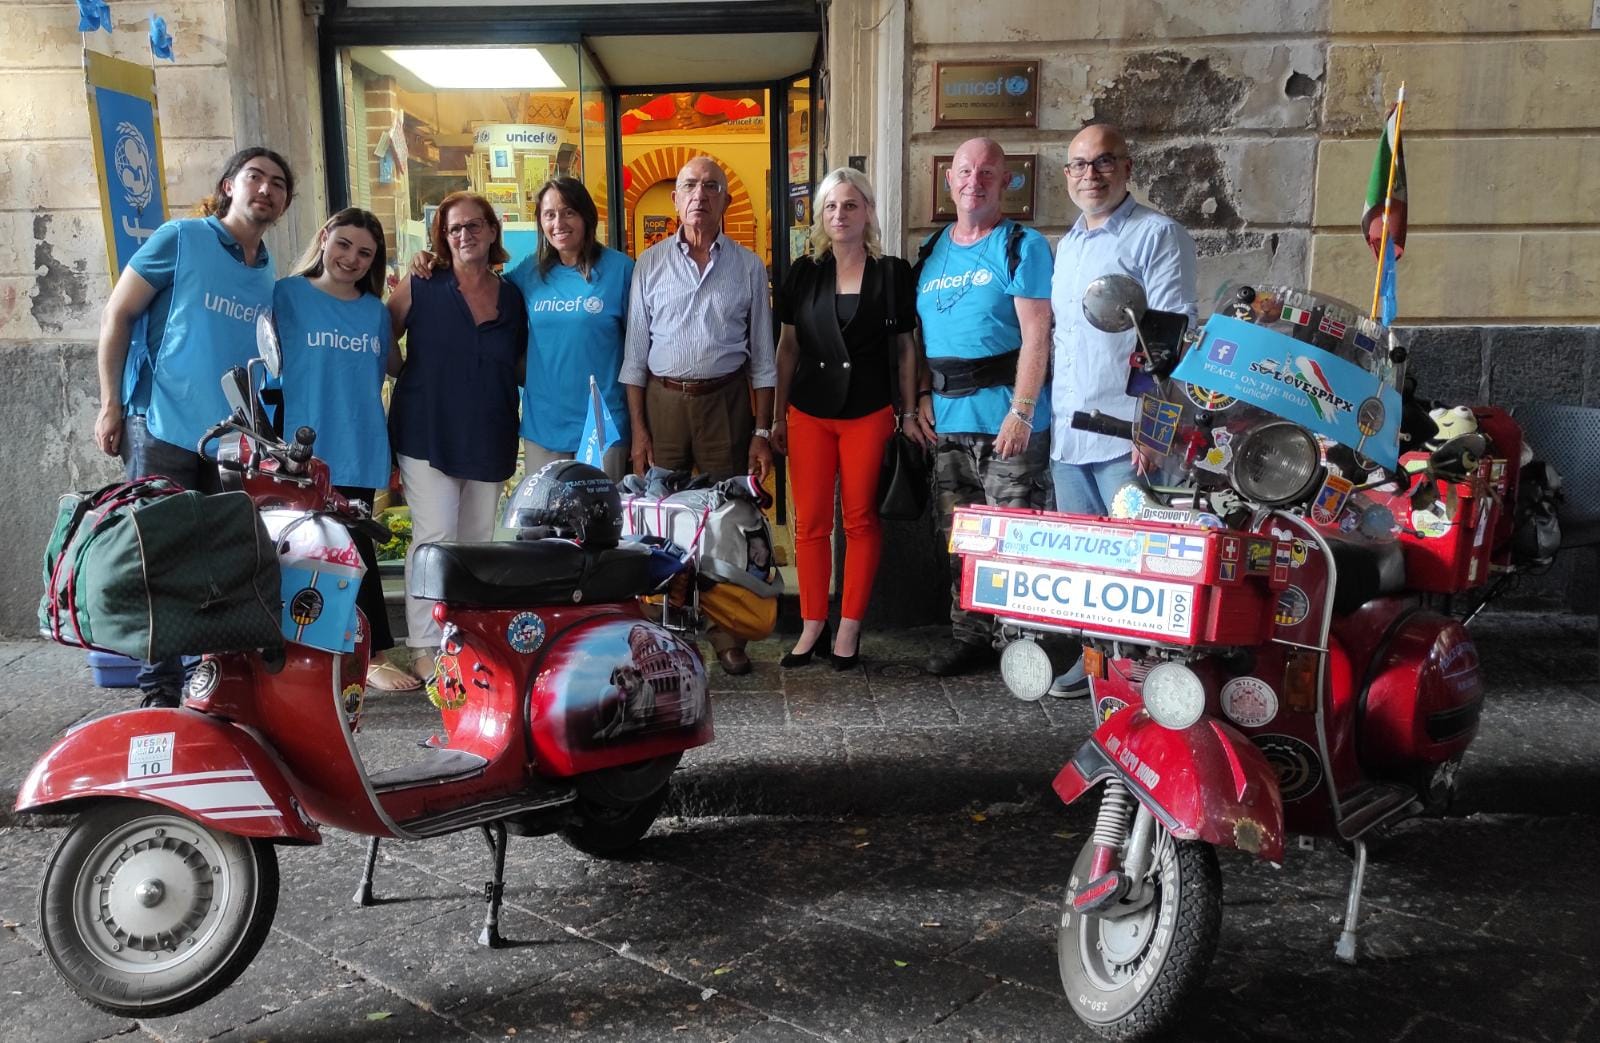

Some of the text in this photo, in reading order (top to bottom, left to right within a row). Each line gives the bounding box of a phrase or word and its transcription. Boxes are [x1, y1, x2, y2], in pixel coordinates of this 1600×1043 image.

[944, 77, 1003, 96] unicef
[506, 130, 545, 143] unicef
[922, 270, 971, 294] unicef
[204, 292, 261, 325] unicef
[534, 296, 583, 312] unicef
[307, 329, 368, 353] unicef
[1203, 362, 1309, 407] PEACE ON THE ROAD
[1242, 386, 1271, 400] unicef
[1030, 531, 1123, 557] CIVATURS
[1013, 571, 1165, 617] BCC LODI
[1011, 602, 1163, 631] CREDITO COOPERATIVO ITALIANO
[1173, 594, 1187, 629] 1909
[1235, 681, 1263, 690] MILAN
[141, 762, 160, 775] 10
